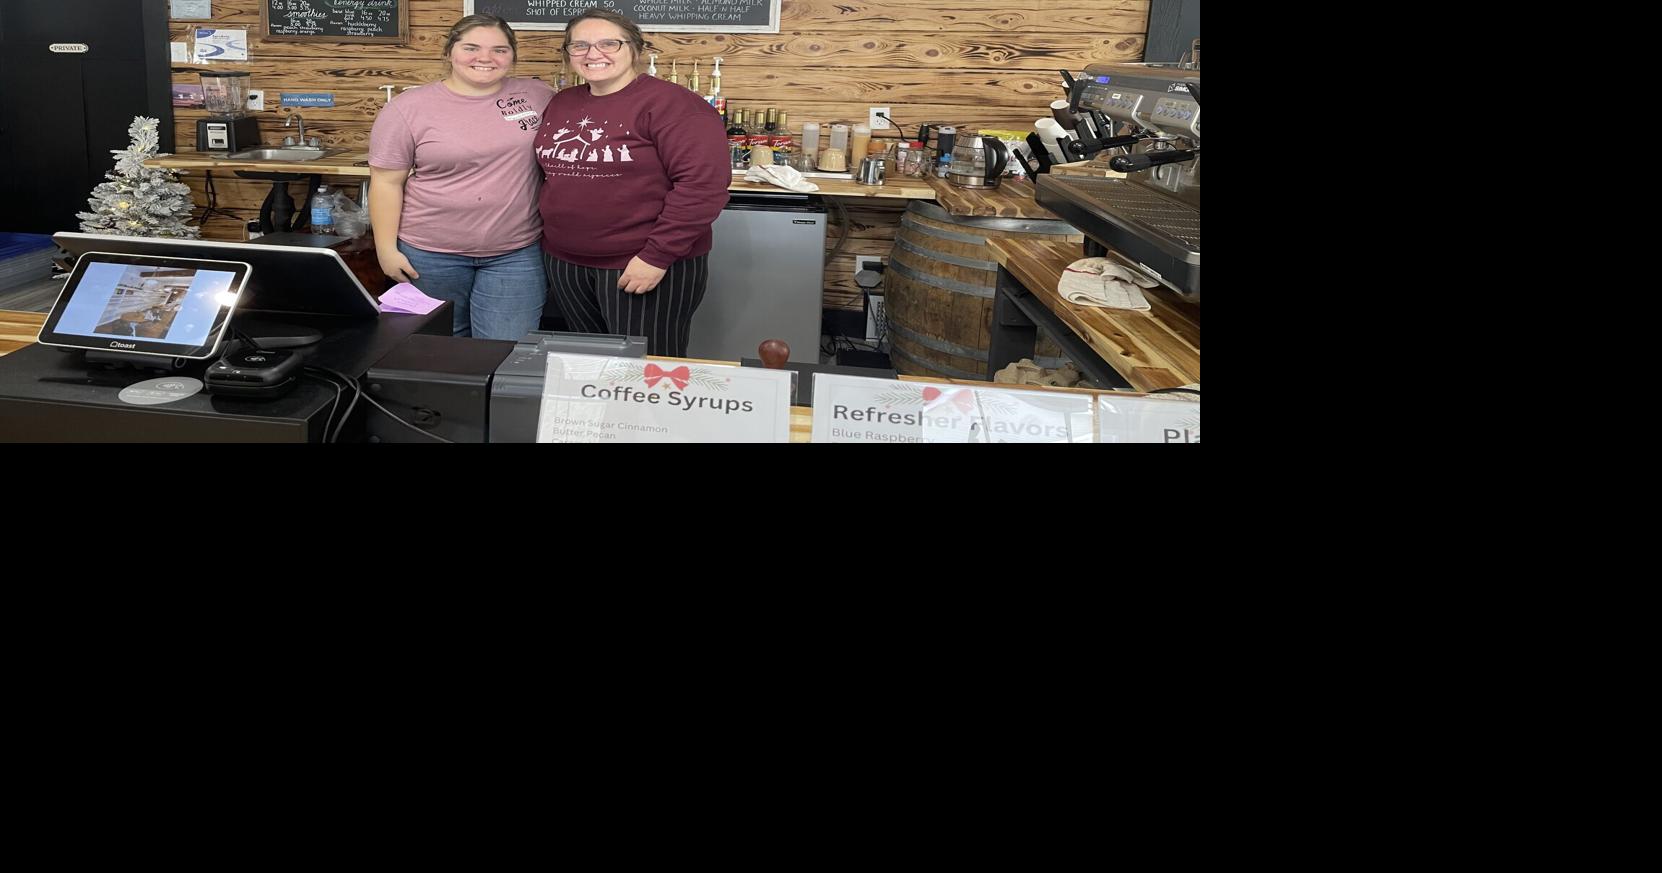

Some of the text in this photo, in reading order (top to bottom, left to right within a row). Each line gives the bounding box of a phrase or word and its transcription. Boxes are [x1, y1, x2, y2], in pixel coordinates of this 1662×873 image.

[527, 0, 566, 8] WHIPPED
[569, 0, 598, 8] CREAM
[633, 4, 666, 12] COCONUT
[283, 8, 328, 19] smoothies
[526, 8, 545, 16] SHOT
[549, 8, 560, 16] OF
[638, 12, 666, 20] HEAVY
[496, 97, 528, 109] Come
[117, 342, 136, 350] toast
[580, 384, 754, 415] Coffee Syrups
[833, 404, 962, 430] Refresher
[553, 416, 669, 434] Brown Sugar Cinnamon
[551, 426, 584, 438] Butter
[586, 430, 617, 441] Pecan
[831, 428, 862, 439] Blue
